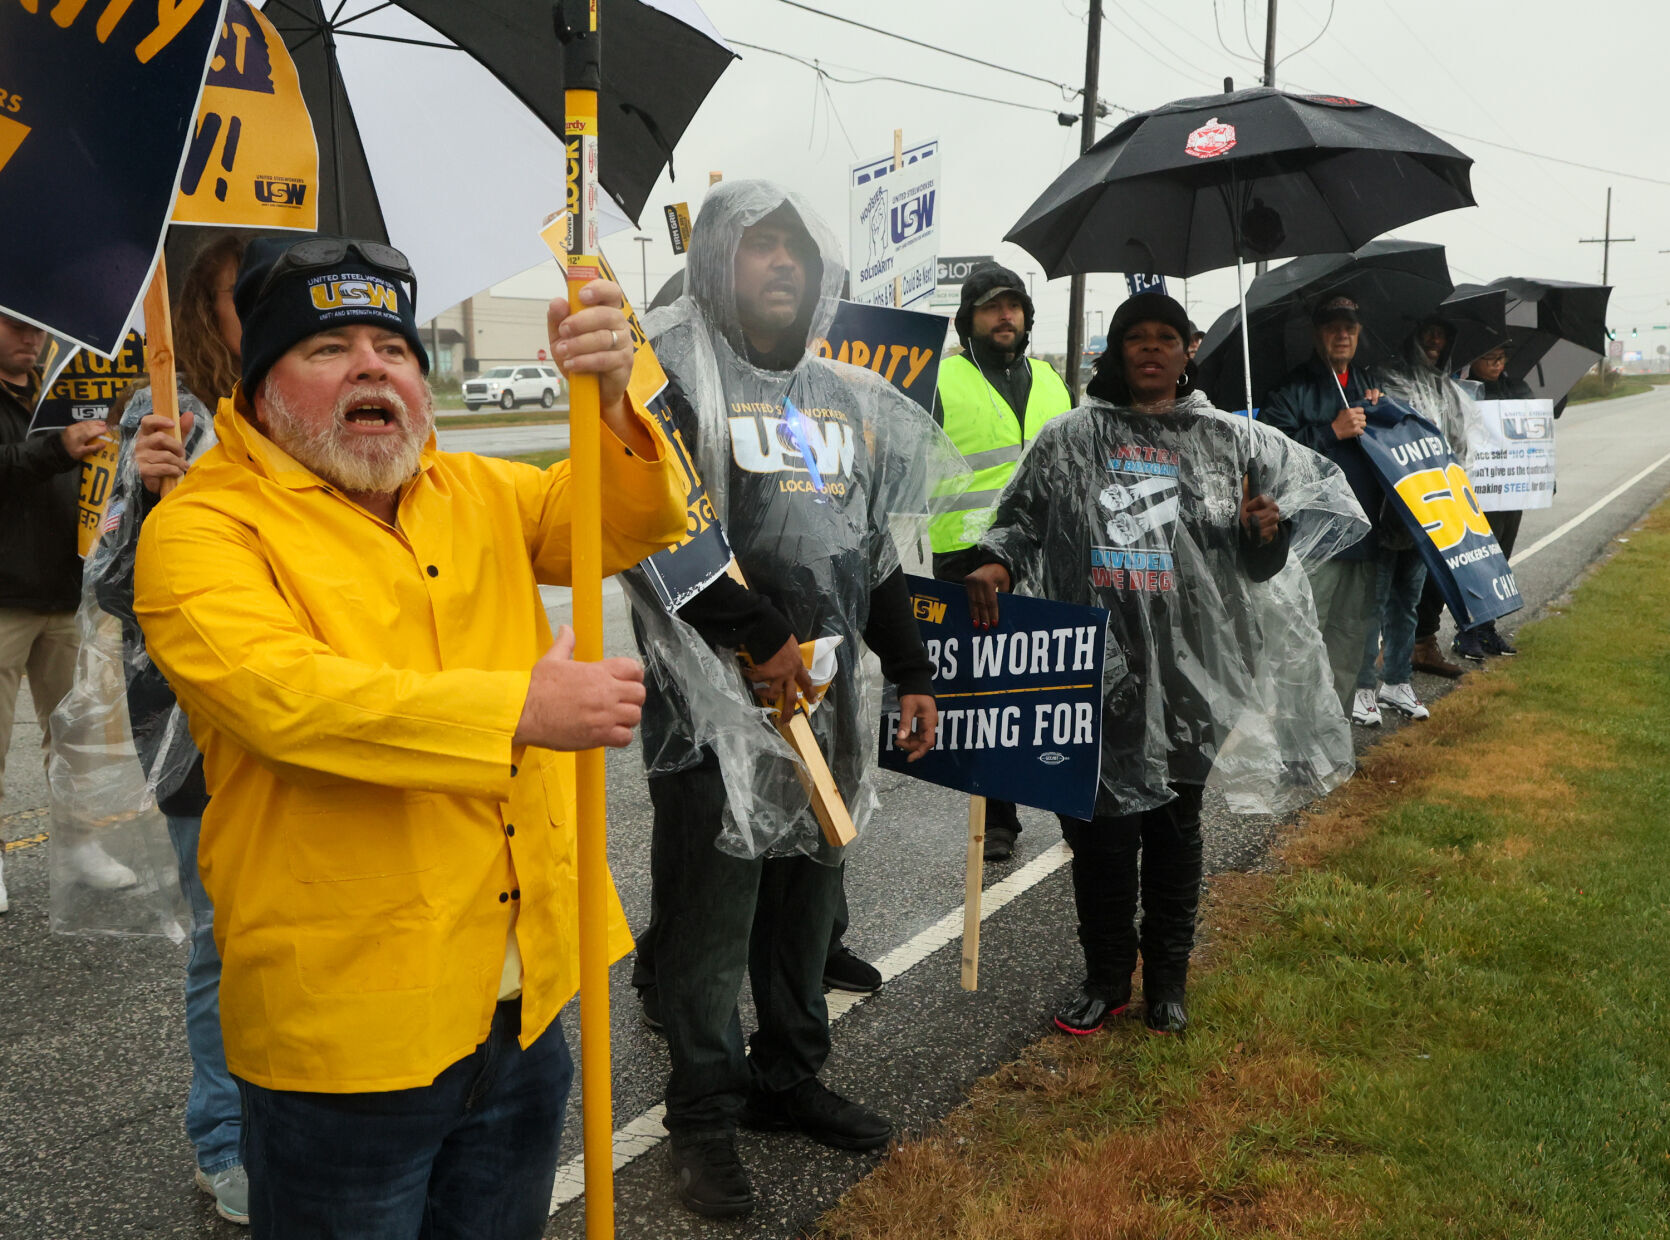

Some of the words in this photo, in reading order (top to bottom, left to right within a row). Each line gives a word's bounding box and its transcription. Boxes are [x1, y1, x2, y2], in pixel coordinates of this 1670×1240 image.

[566, 139, 580, 215] LOCK
[254, 180, 307, 206] USW
[890, 189, 936, 244] USW
[307, 274, 339, 286] UNITED
[341, 273, 396, 292] STEELWORKERS
[860, 256, 894, 283] SOLIDARITY
[309, 280, 398, 314] USW
[72, 406, 110, 421] USW
[731, 402, 774, 413] UNITED
[727, 416, 855, 480] USW
[1490, 466, 1506, 478] give
[779, 480, 818, 494] LOCAL
[1474, 483, 1502, 495] making
[1503, 482, 1529, 494] STEEL
[1091, 549, 1174, 571] DIVIDED
[1092, 567, 1124, 590] WE
[910, 596, 948, 624] SW
[972, 625, 1097, 679] WORTH
[885, 706, 1021, 751] FHTING
[1032, 702, 1094, 746] FOR
